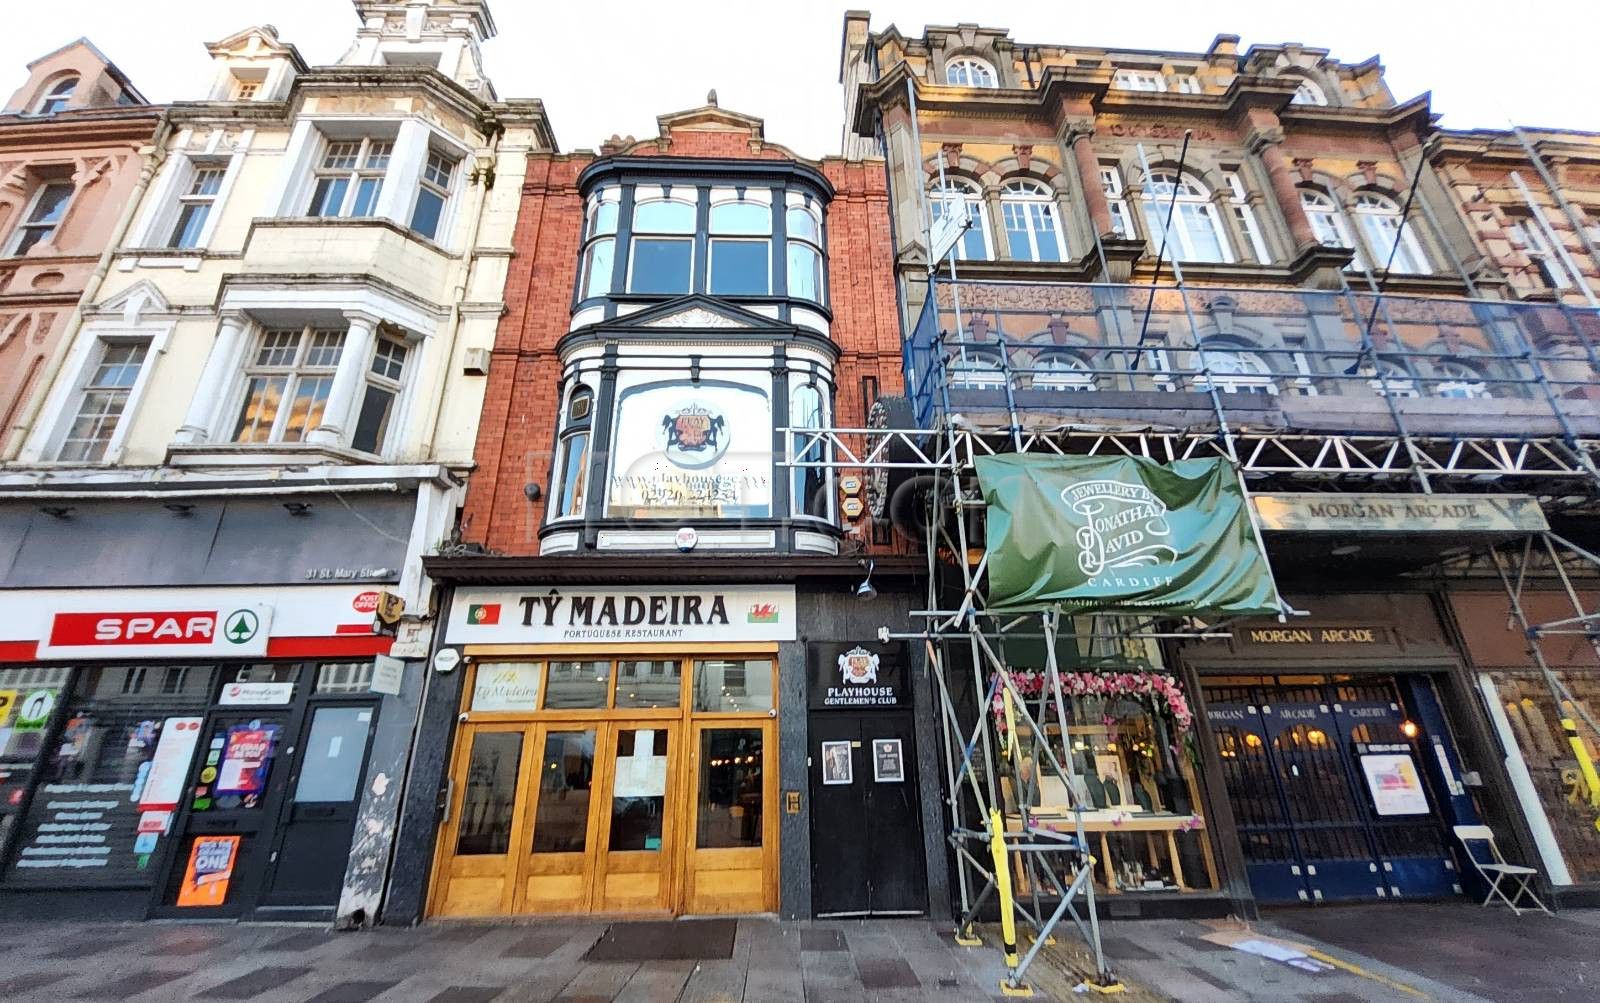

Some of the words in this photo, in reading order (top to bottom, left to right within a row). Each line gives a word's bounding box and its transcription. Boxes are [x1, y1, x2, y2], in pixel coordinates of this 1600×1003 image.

[1071, 483, 1138, 500] JEWELLERY
[1308, 503, 1395, 518] MORGAN
[1404, 504, 1479, 519] ARCADE
[334, 568, 358, 579] Mary
[1087, 576, 1173, 587] CARDIFF
[354, 601, 377, 609] OFFIC
[568, 594, 730, 626] MADEIRA
[94, 617, 214, 640] SPAR
[563, 629, 622, 638] PORTUGUESE
[625, 629, 684, 638] RESTAURANT
[1251, 630, 1312, 643] MORGAN
[1321, 630, 1375, 643] ARCADE
[828, 687, 893, 697] PLAYHOUSE
[824, 697, 877, 705] GENTLEMEN'S
[878, 696, 897, 704] CLUB
